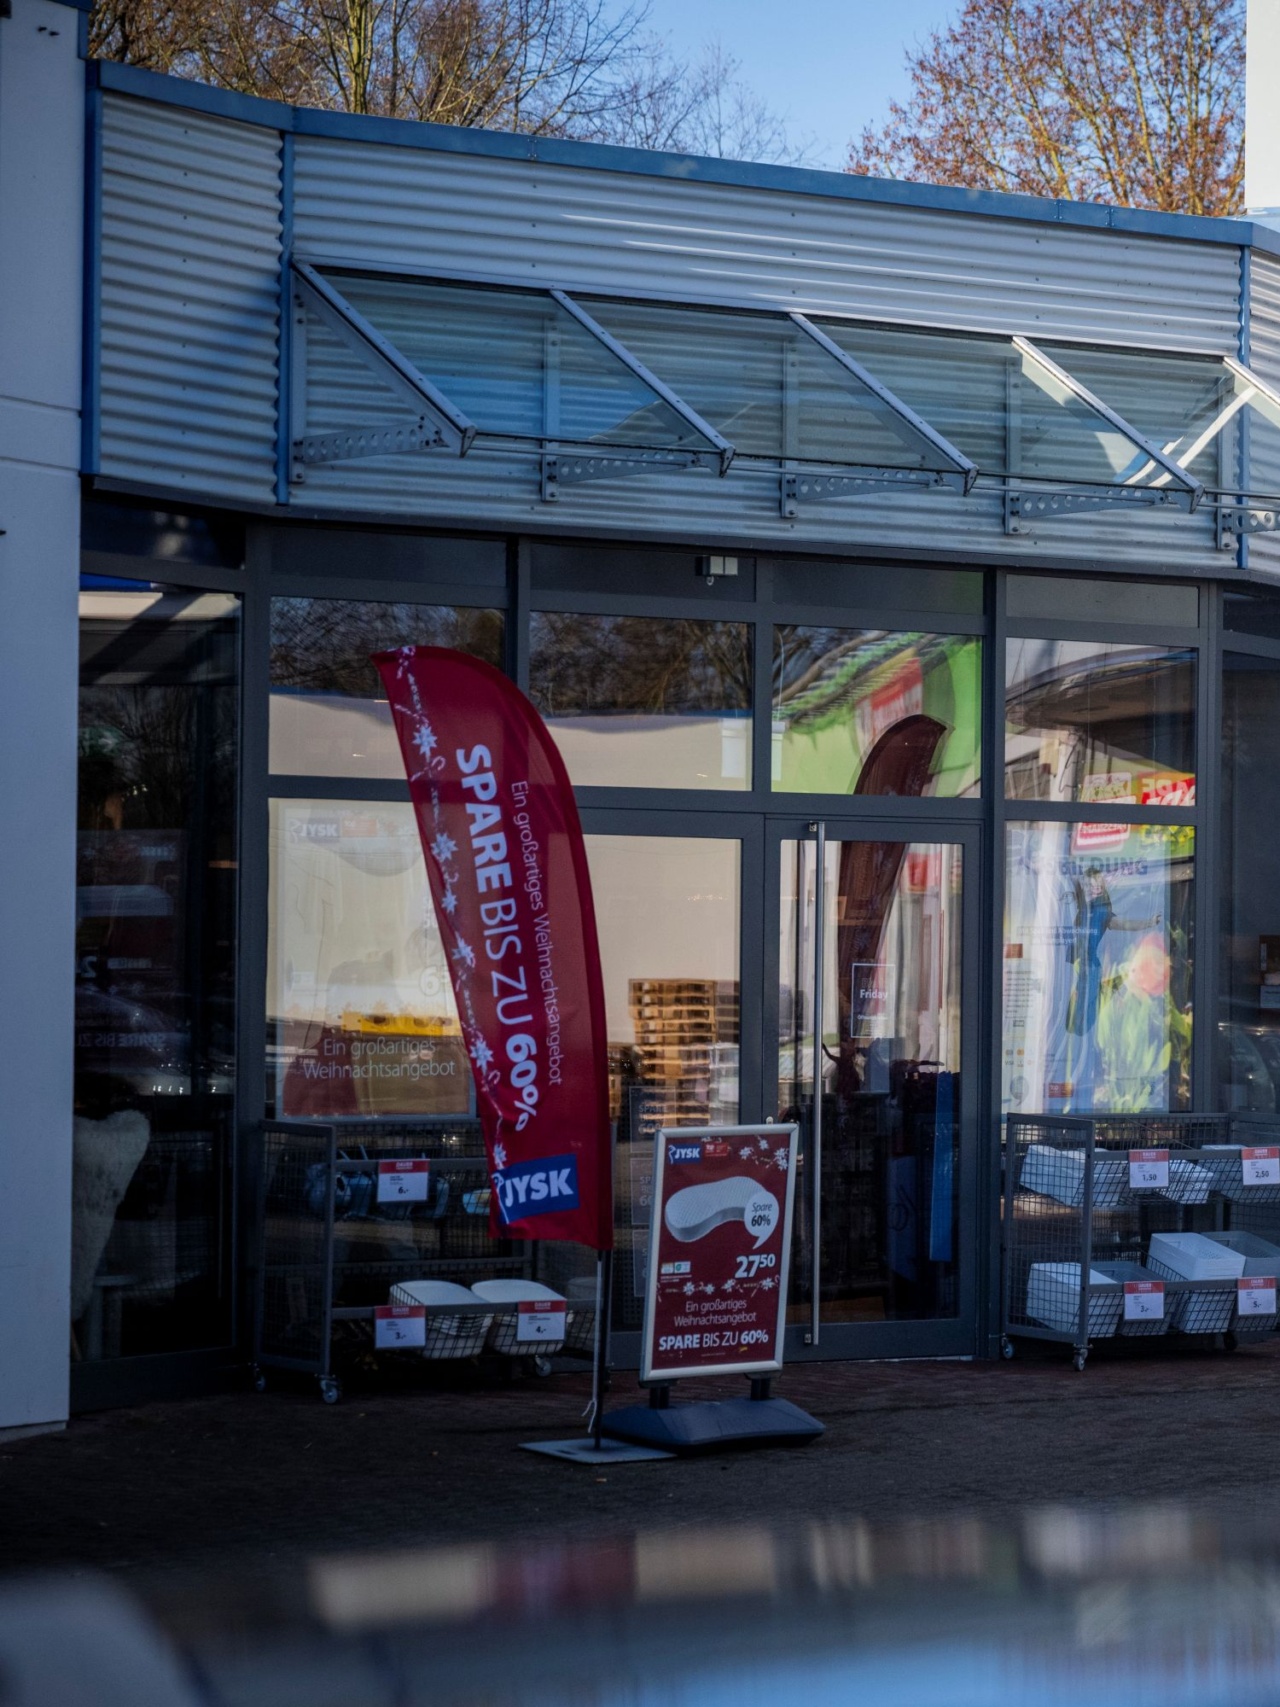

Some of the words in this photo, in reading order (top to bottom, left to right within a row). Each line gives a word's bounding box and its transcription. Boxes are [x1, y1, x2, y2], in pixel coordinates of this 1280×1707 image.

[511, 780, 528, 808] Ein
[456, 743, 513, 894] SPARE
[301, 823, 338, 837] JYSK
[513, 811, 544, 911] großartiges
[480, 898, 522, 961] BIS
[490, 965, 534, 1026] ZU
[534, 912, 563, 1086] Weihnachtsangebot
[859, 988, 888, 1002] Friday
[323, 1038, 346, 1056] Ein
[350, 1037, 437, 1060] großartiges
[303, 1060, 456, 1081] Weihnachtsangebot
[505, 1033, 539, 1132] 60%
[674, 1147, 700, 1159] JYSK
[504, 1167, 574, 1208] JYSK
[751, 1201, 773, 1213] Spare
[751, 1214, 771, 1227] 60%
[685, 1300, 699, 1313] Ein
[700, 1299, 747, 1315] großartiges
[674, 1312, 757, 1328] Weihnachtsangebot
[658, 1333, 701, 1351] SPARE
[702, 1332, 720, 1348] BIS
[721, 1331, 739, 1347] ZU
[740, 1329, 769, 1345] 60%
